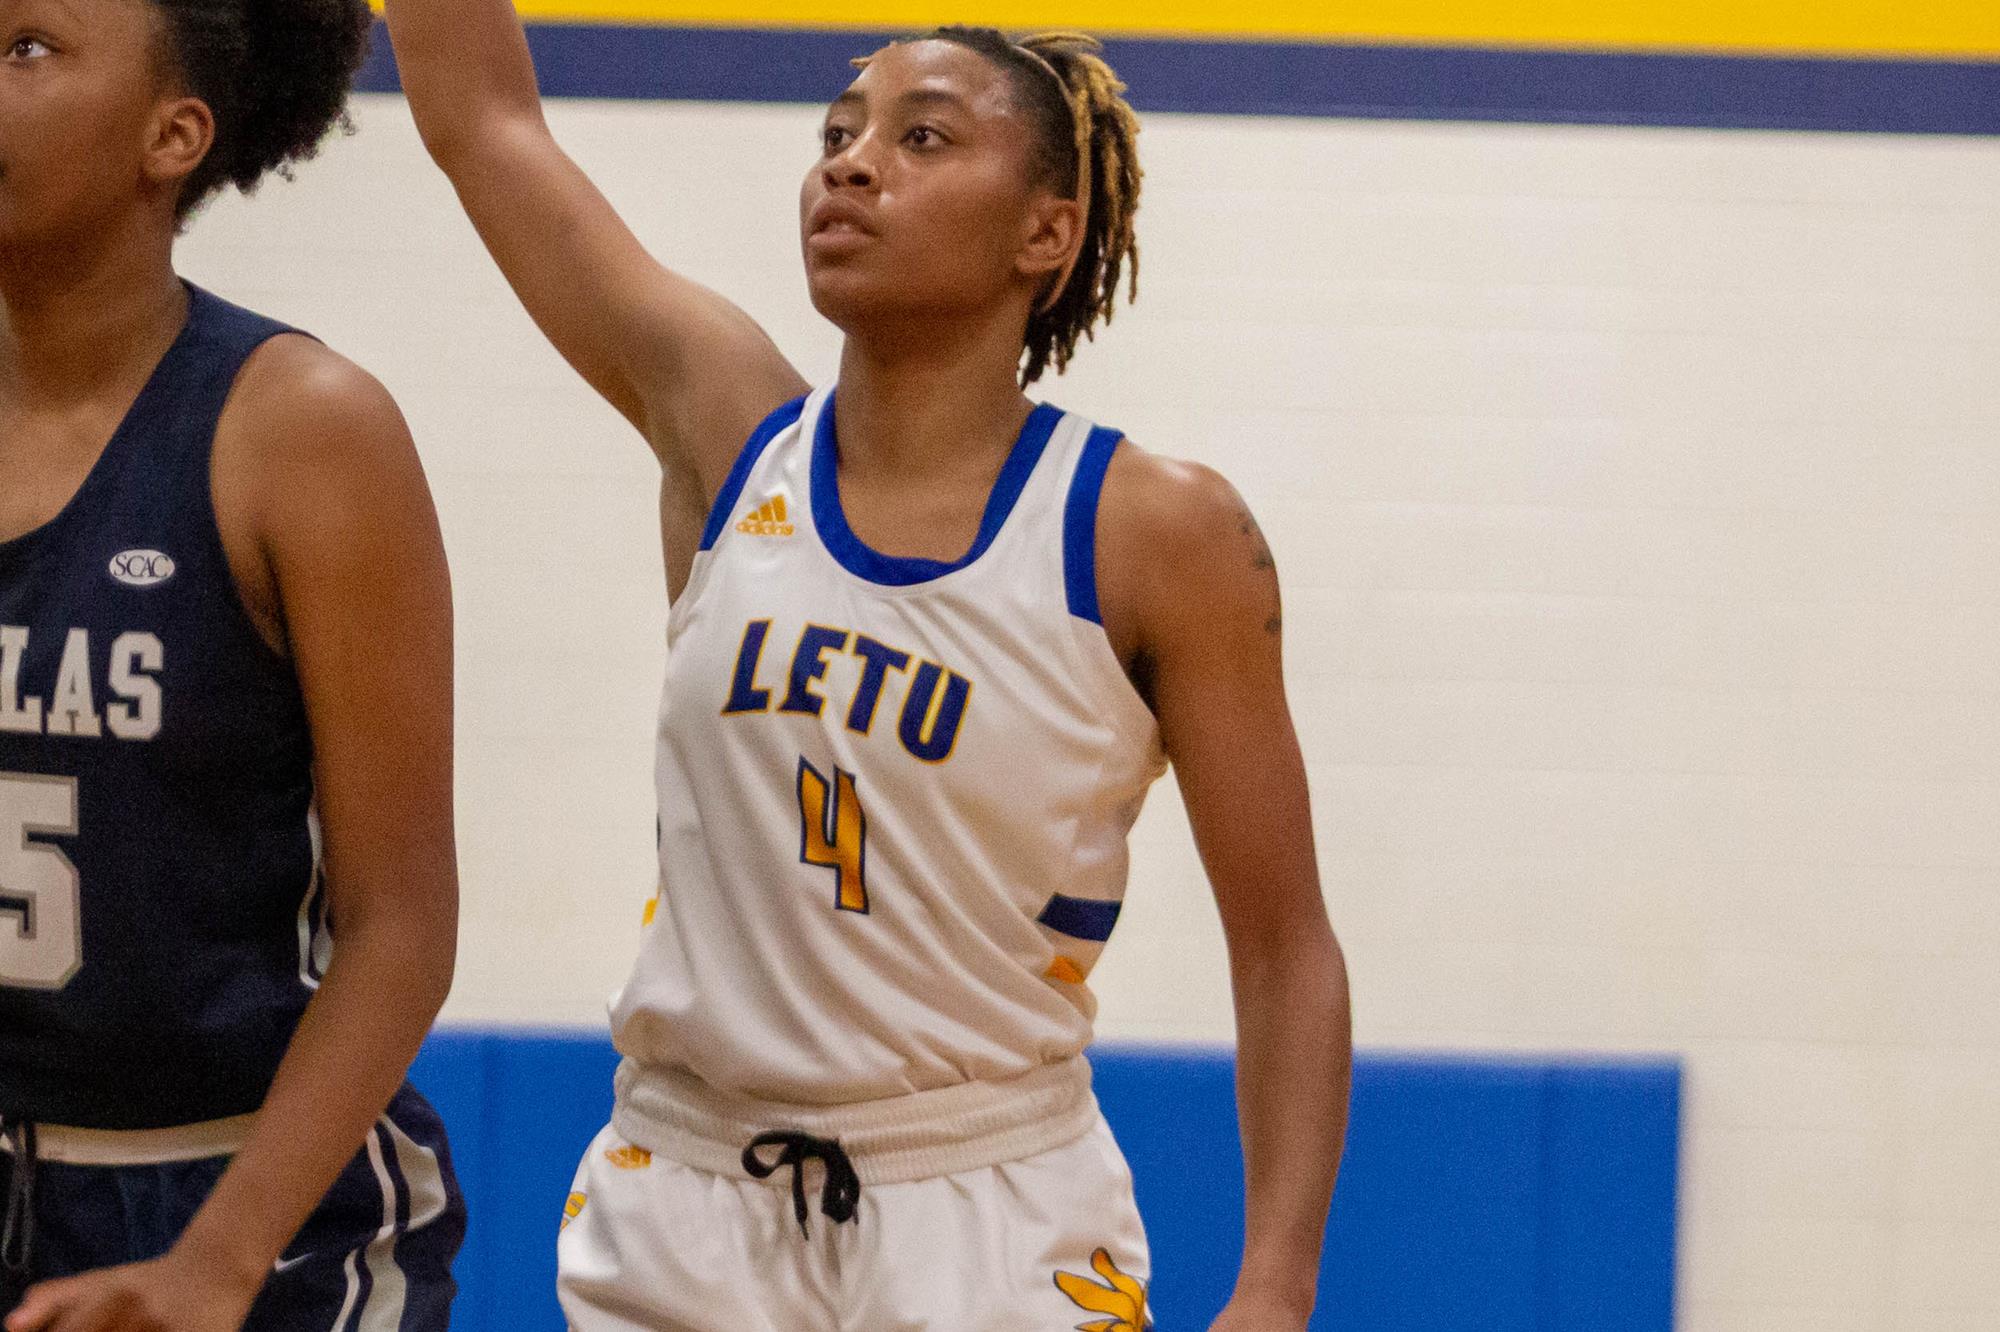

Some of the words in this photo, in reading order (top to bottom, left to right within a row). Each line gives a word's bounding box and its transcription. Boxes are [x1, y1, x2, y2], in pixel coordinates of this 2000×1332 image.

[113, 554, 169, 577] SCAC
[0, 623, 164, 741] LAS
[720, 617, 973, 766] LETU
[0, 771, 83, 990] 5
[797, 754, 870, 915] 4
